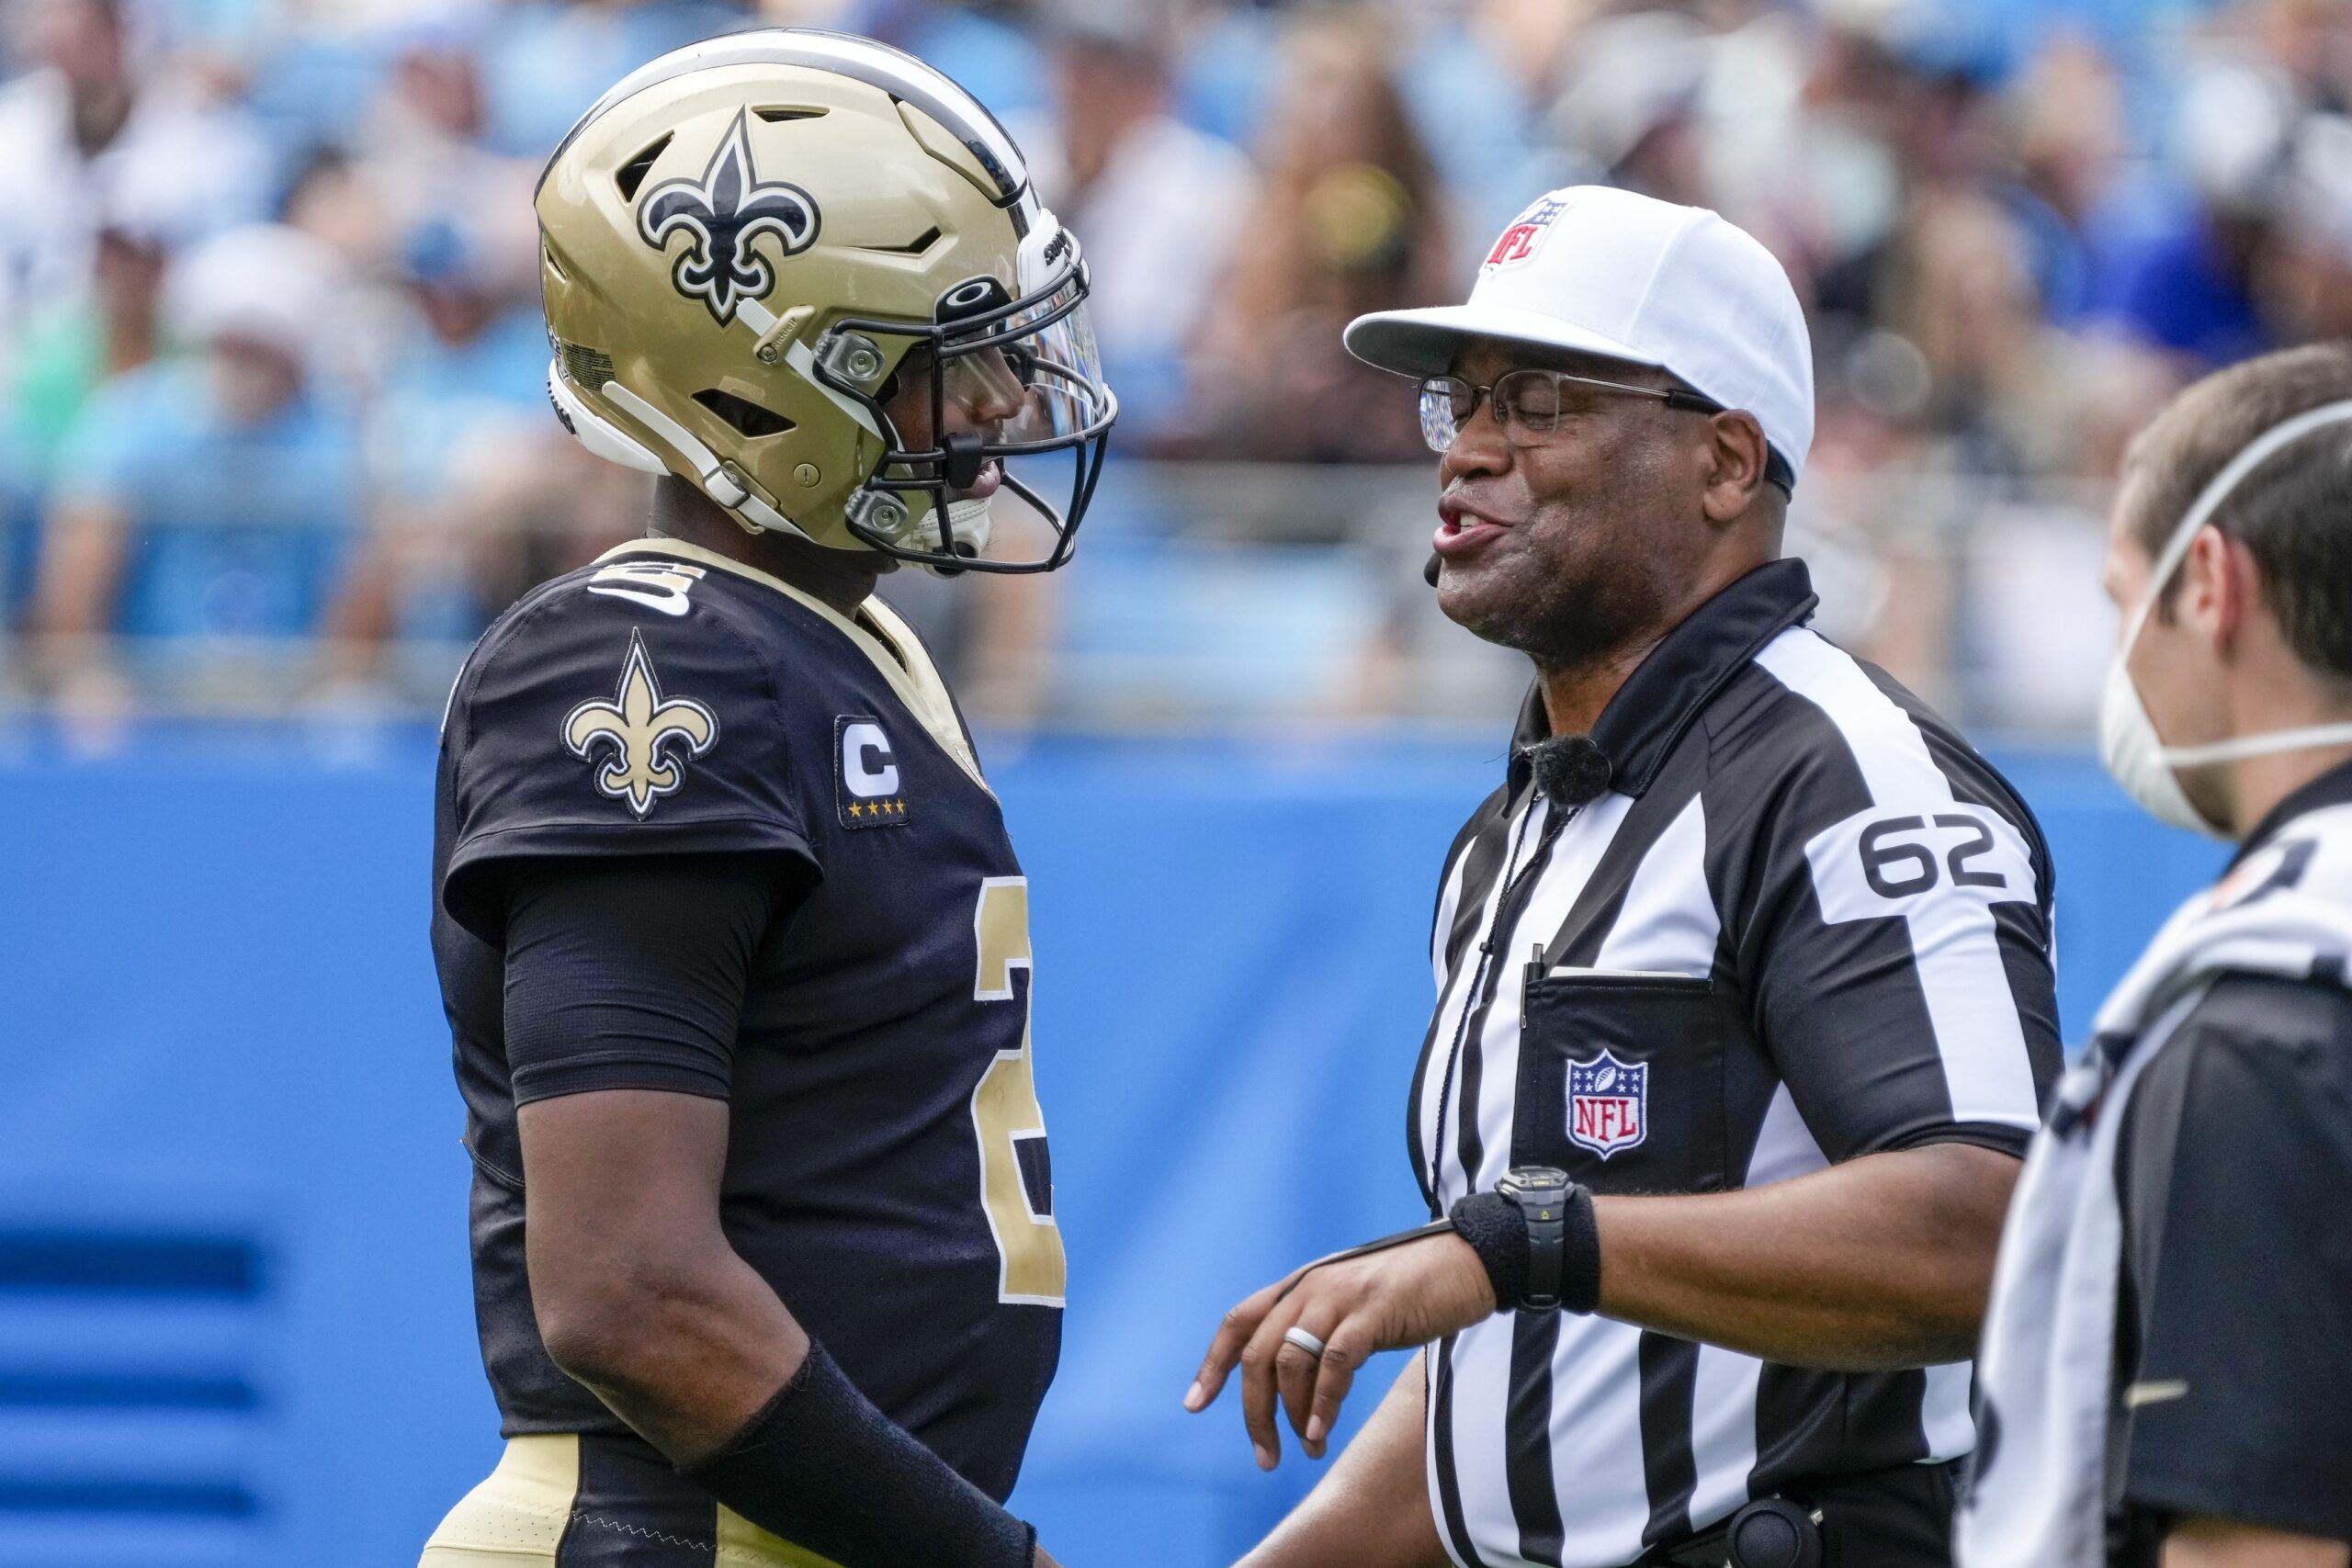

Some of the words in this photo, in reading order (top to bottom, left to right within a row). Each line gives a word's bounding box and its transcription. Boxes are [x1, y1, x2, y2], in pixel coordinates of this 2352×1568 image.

[842, 723, 899, 797] C
[1859, 813, 2007, 899] 62
[970, 876, 1067, 1308] 2
[1575, 1098, 1637, 1143] NFL
